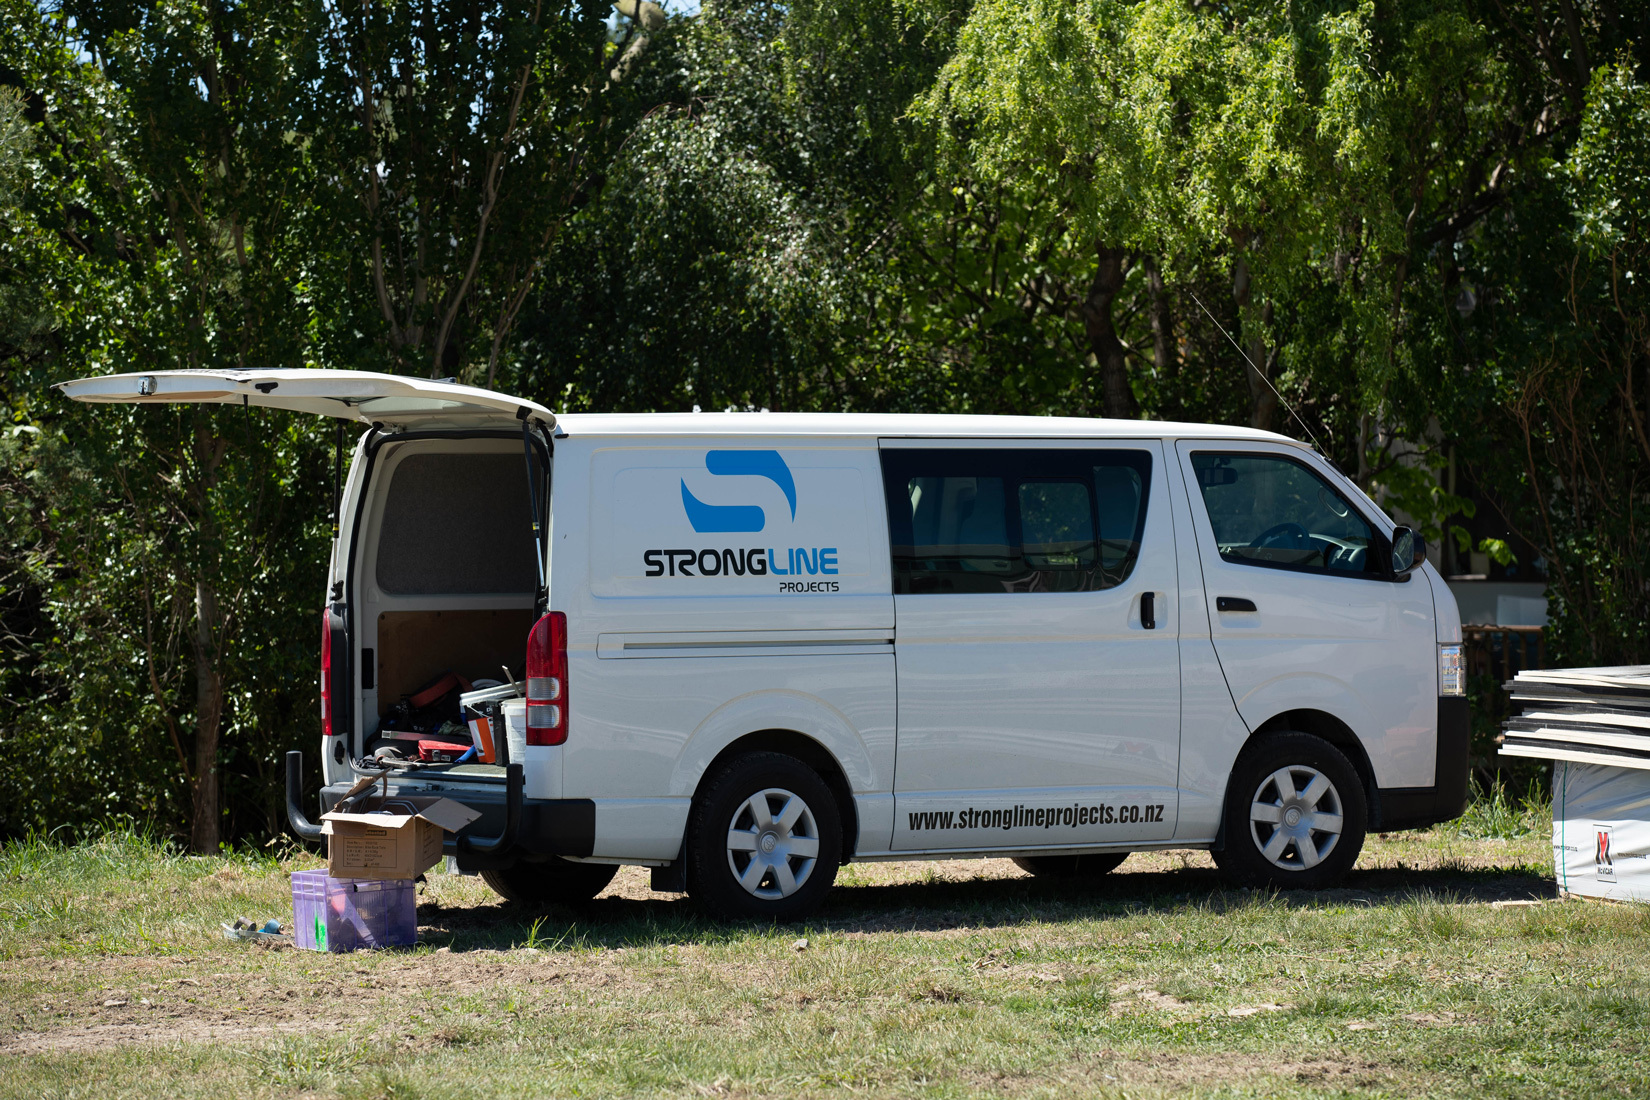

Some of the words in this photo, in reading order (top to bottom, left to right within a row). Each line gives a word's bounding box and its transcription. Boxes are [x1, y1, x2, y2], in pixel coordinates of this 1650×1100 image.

[644, 548, 838, 577] STRONGLINE
[779, 581, 840, 593] PROJECTS
[908, 803, 1165, 831] www.stronglineprojects.co.nz
